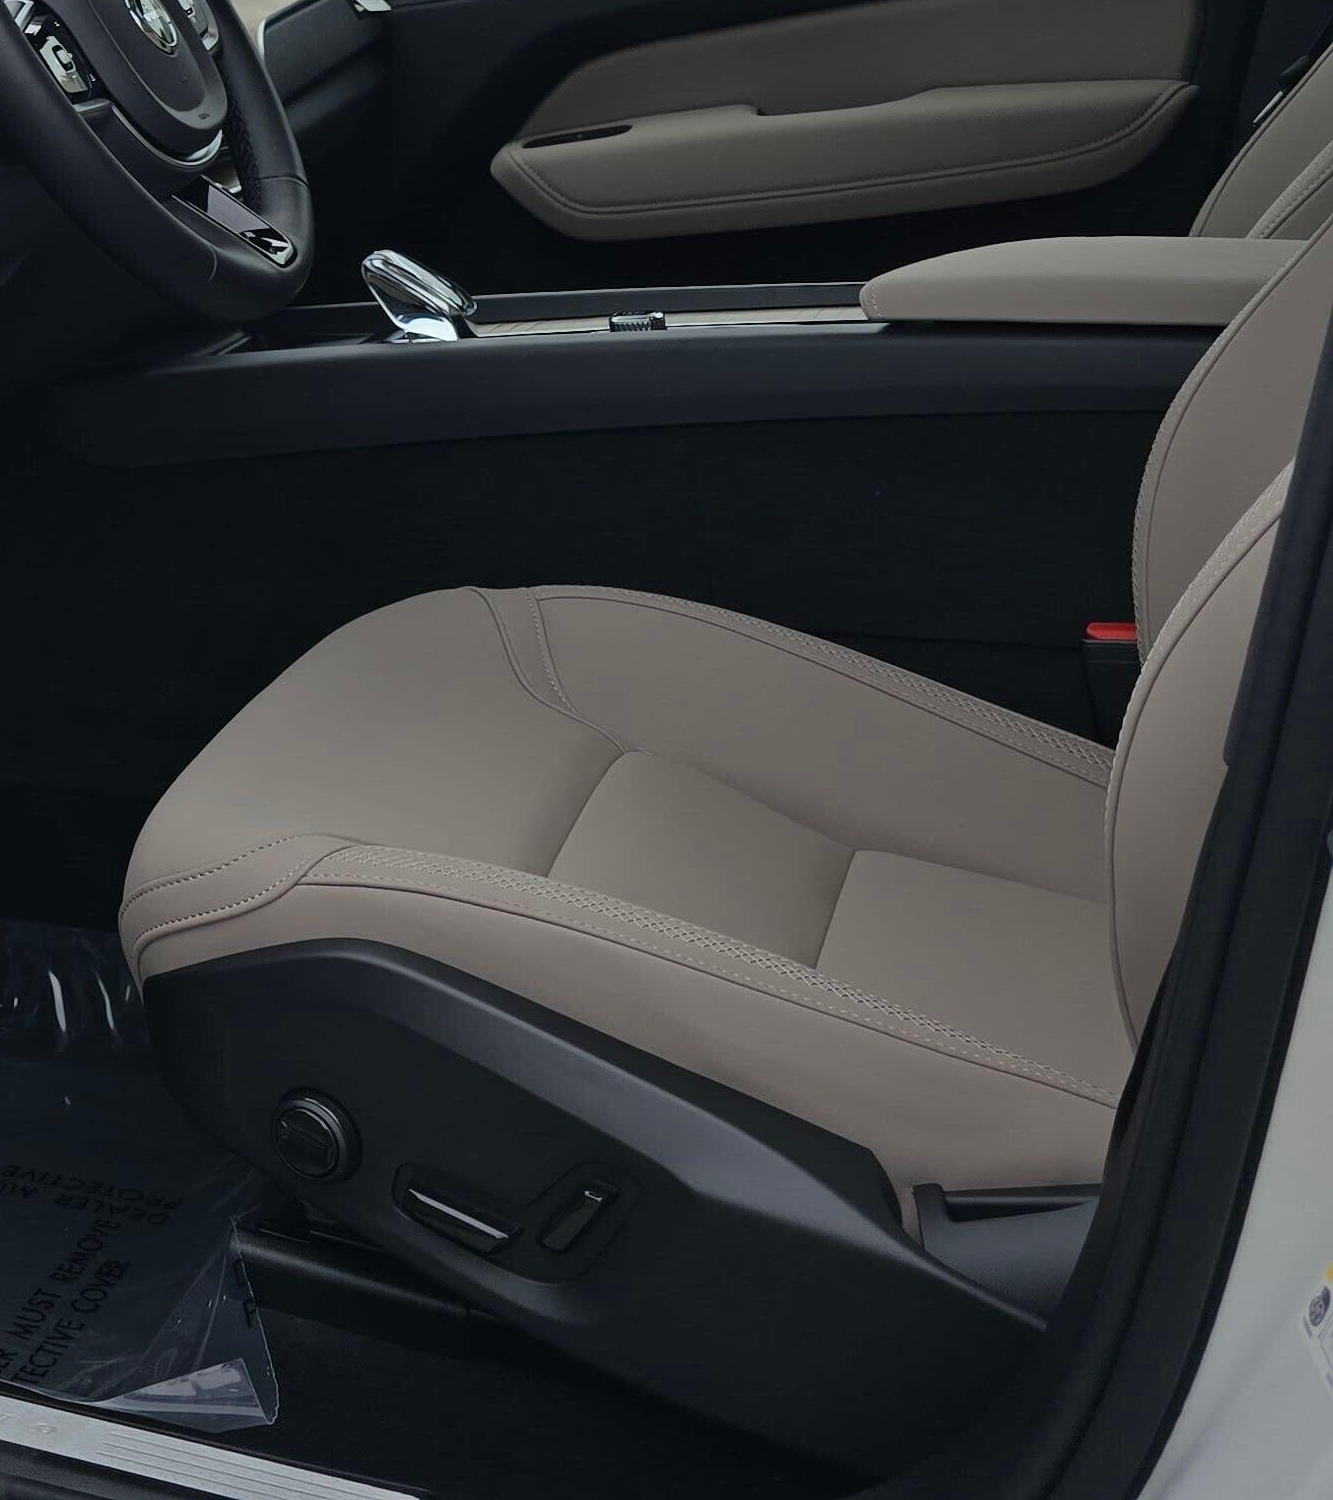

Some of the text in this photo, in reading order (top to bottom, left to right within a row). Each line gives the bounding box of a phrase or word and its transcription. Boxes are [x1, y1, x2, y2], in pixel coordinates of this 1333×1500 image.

[55, 1192, 171, 1227] DEALER
[5, 1287, 62, 1341] MUST
[49, 1218, 121, 1284] REMOVE
[9, 1259, 132, 1386] TECTIVE COVER
